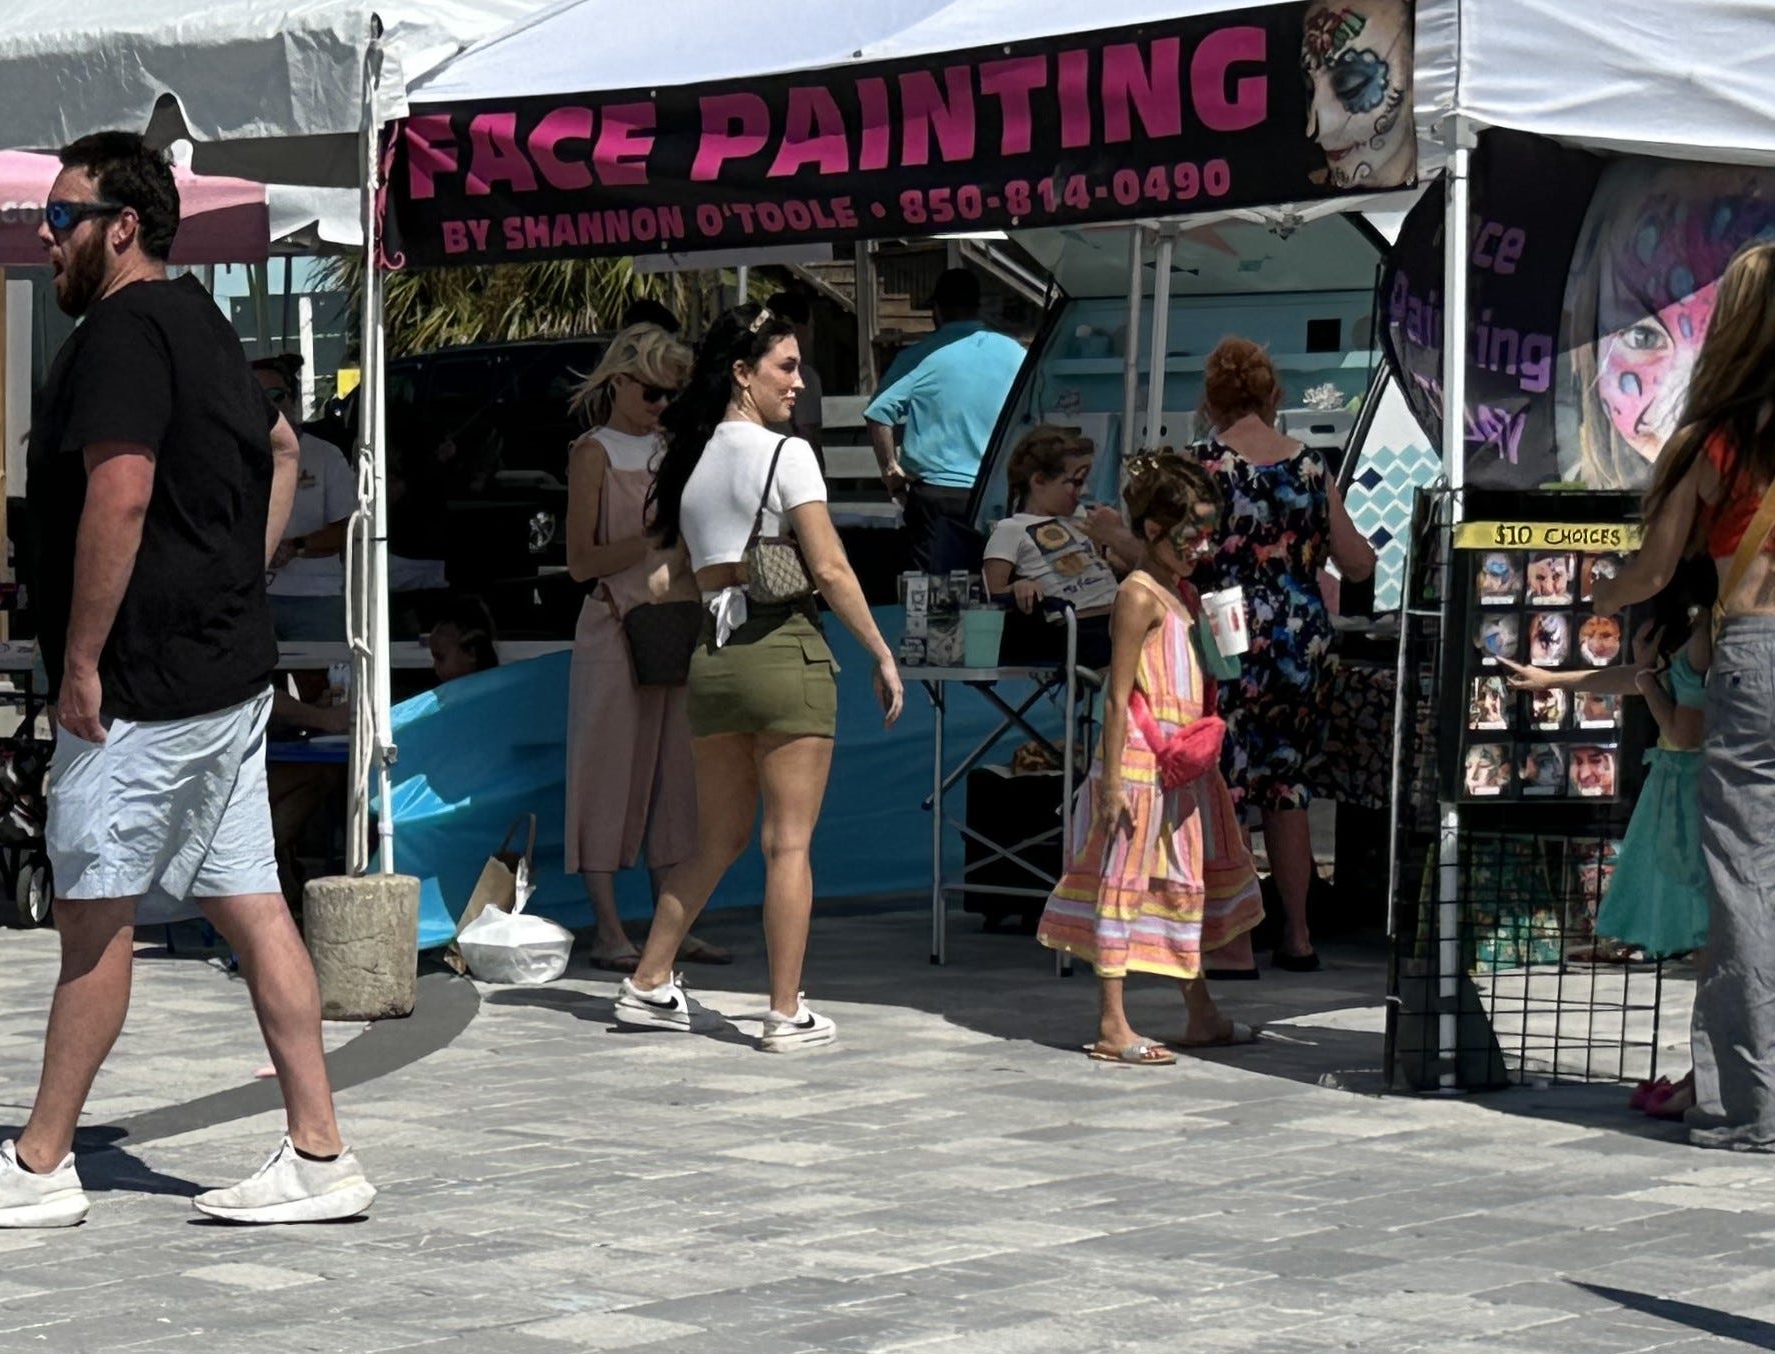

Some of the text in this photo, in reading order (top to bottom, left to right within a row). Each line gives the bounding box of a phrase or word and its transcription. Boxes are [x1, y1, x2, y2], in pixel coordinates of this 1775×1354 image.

[405, 26, 1268, 200] FACE PAINTING
[441, 159, 1231, 255] BY SHANNON O'TOOLE 850-814-0490
[1494, 524, 1621, 546] $10 CHOICES
